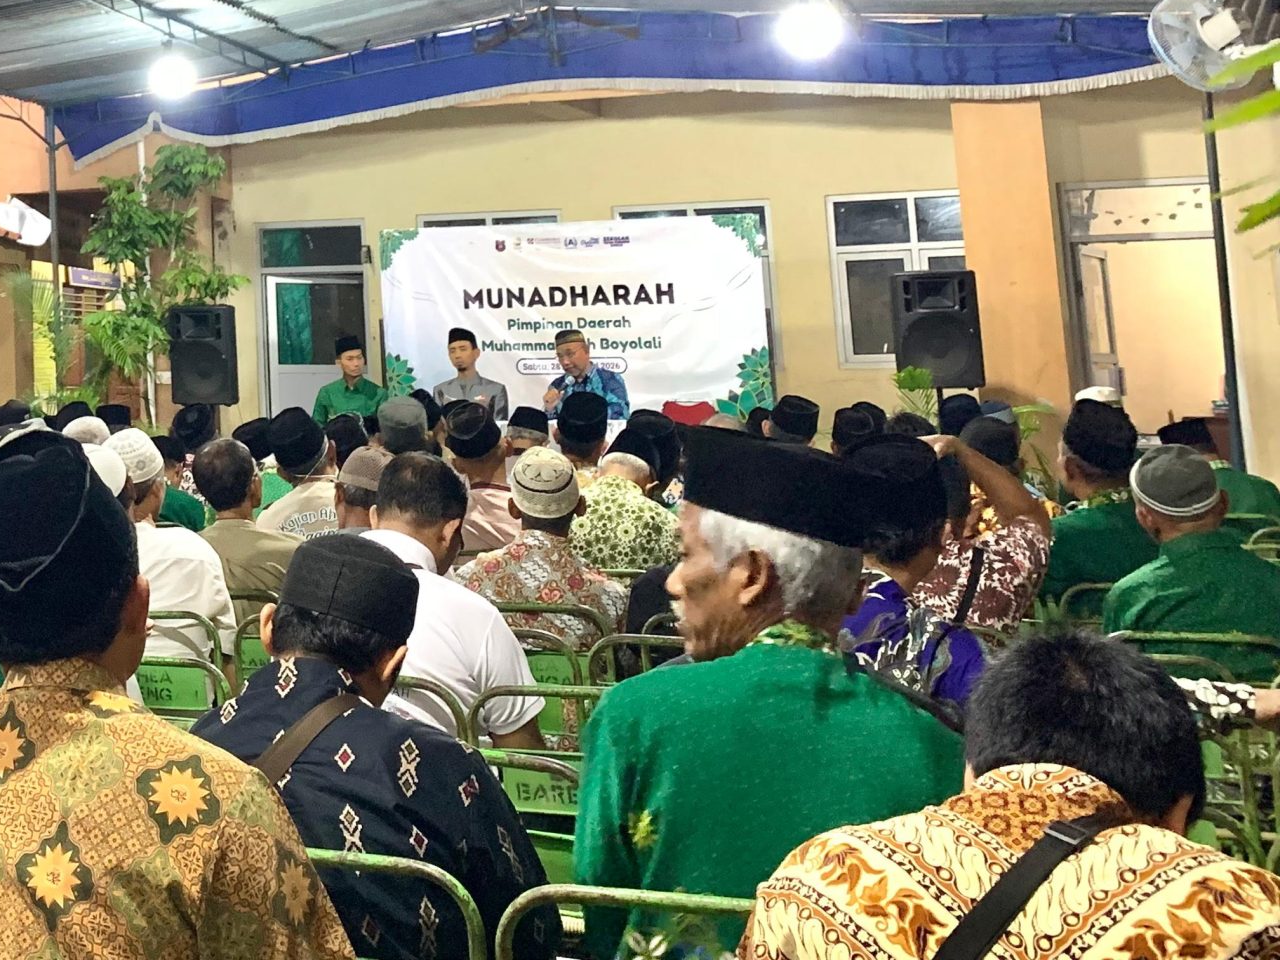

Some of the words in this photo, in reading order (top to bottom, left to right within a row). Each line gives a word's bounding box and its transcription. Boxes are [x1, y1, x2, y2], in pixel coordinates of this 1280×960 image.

[463, 283, 675, 310] MUNADHARAH
[507, 317, 573, 333] Pimpinan
[577, 316, 631, 329] Daerah
[600, 336, 662, 353] Boyolali
[279, 510, 317, 532] Kajian
